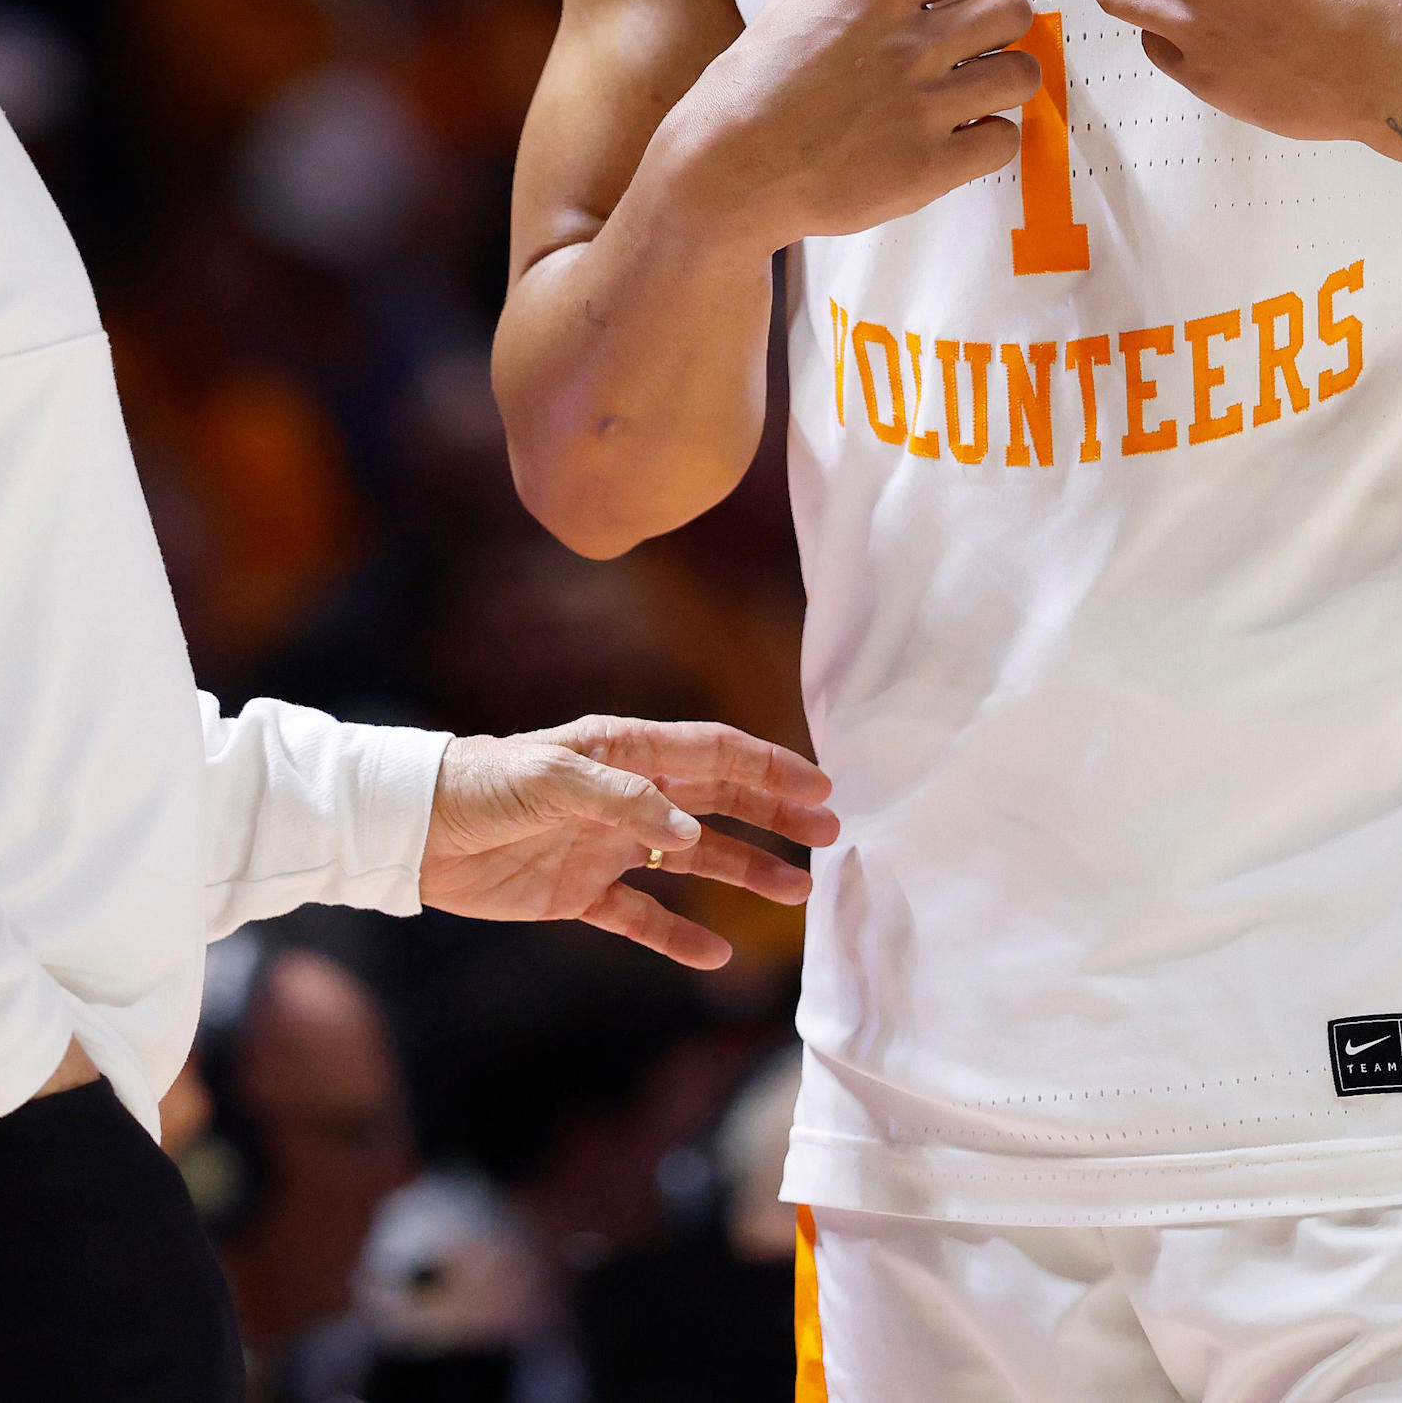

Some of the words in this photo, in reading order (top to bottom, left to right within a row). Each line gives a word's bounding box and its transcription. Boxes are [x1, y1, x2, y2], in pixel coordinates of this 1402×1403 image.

[1004, 11, 1090, 277] 1
[829, 258, 1365, 467] VOLUNTEERS
[1346, 1061, 1397, 1075] TEAM
